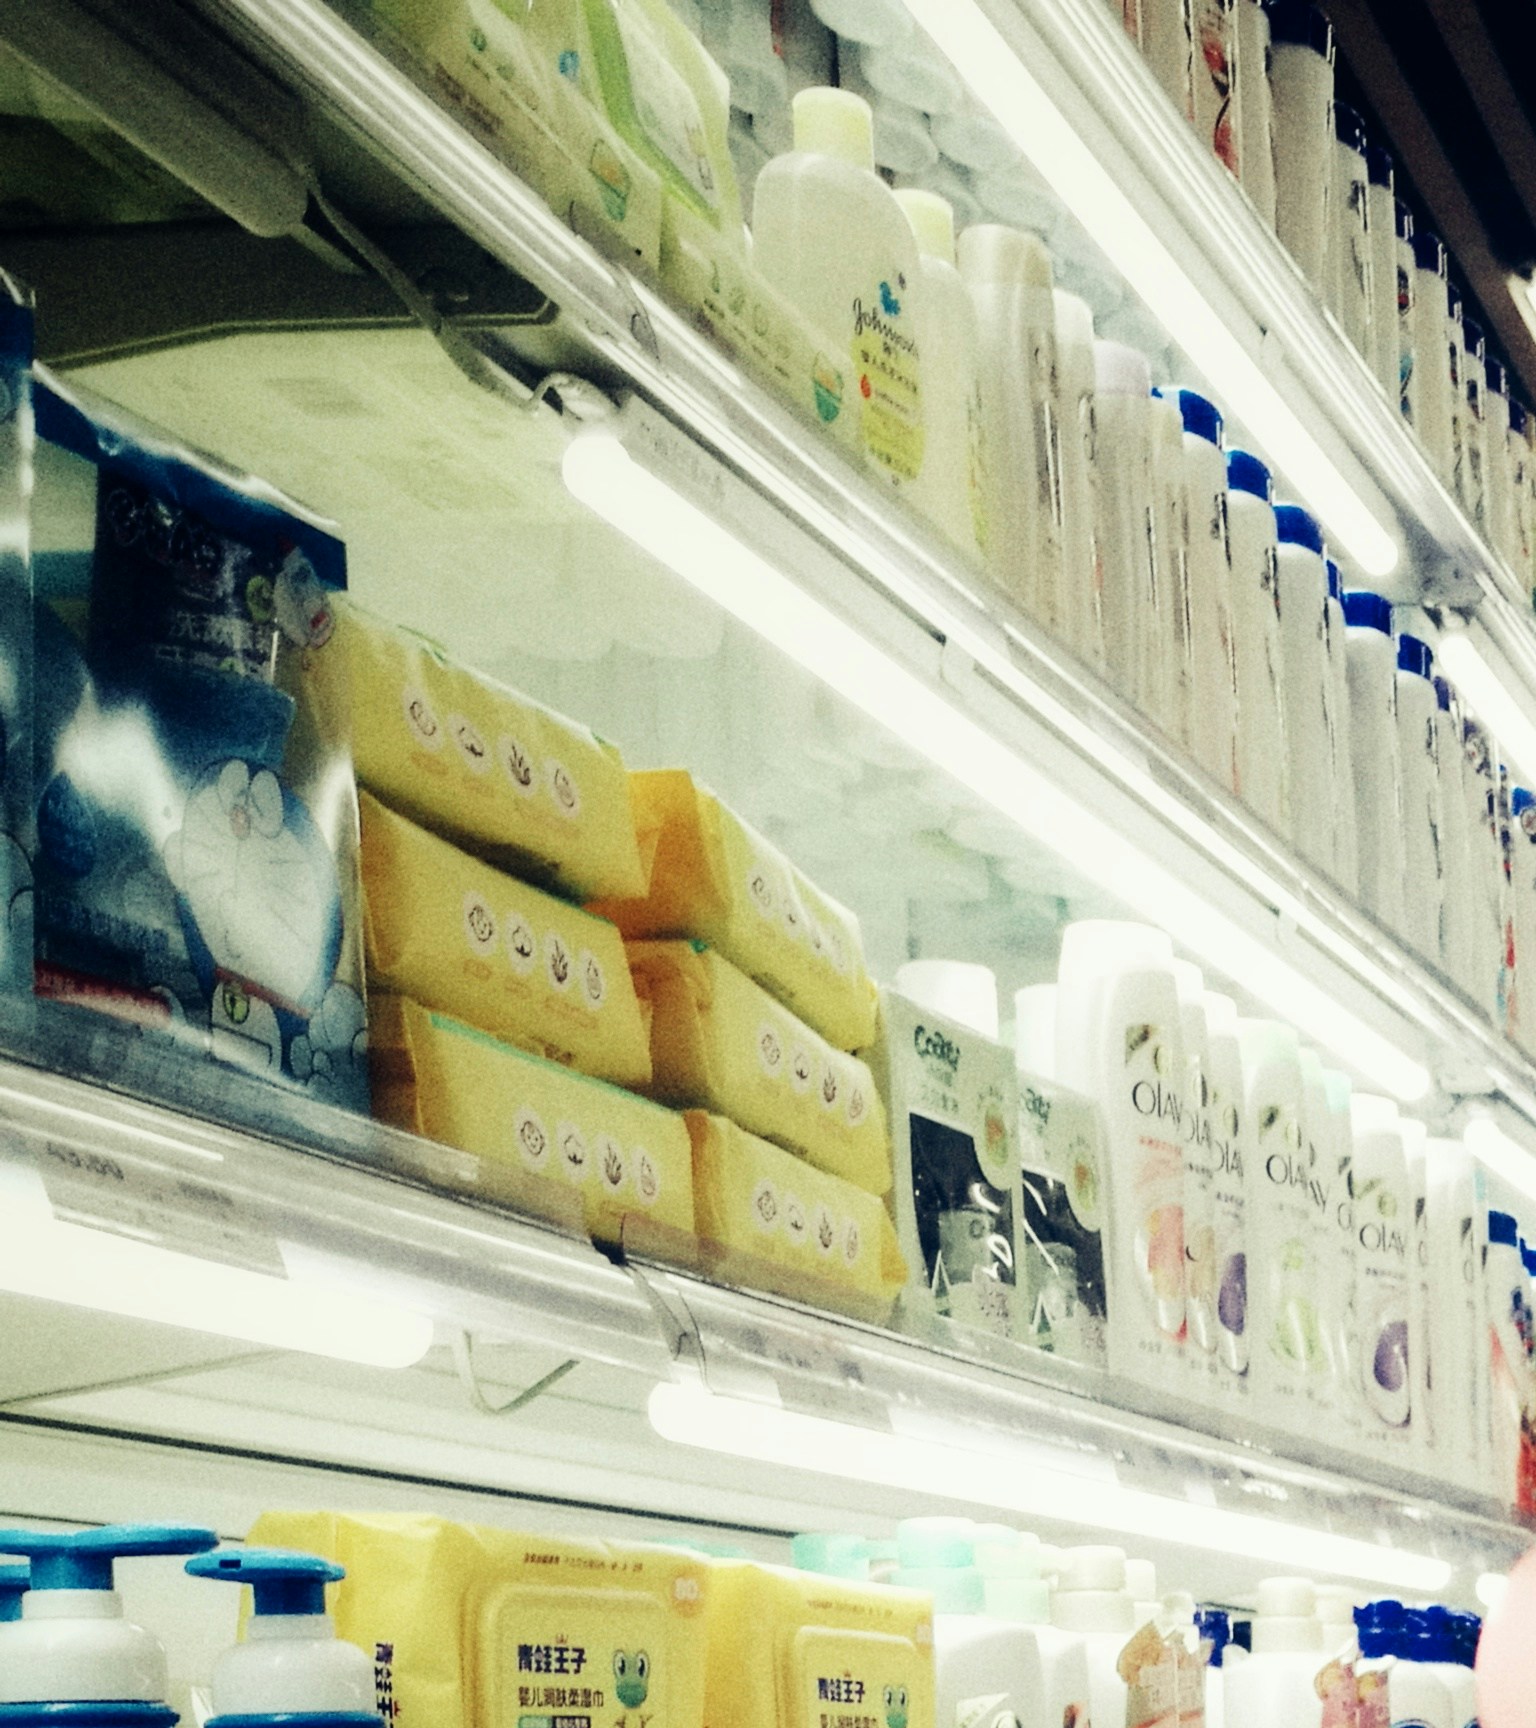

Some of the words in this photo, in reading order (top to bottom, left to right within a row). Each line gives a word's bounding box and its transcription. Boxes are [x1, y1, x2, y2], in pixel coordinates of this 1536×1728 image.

[518, 1645, 588, 1674] 青蛙王子
[818, 1677, 866, 1704] 青蛙王子
